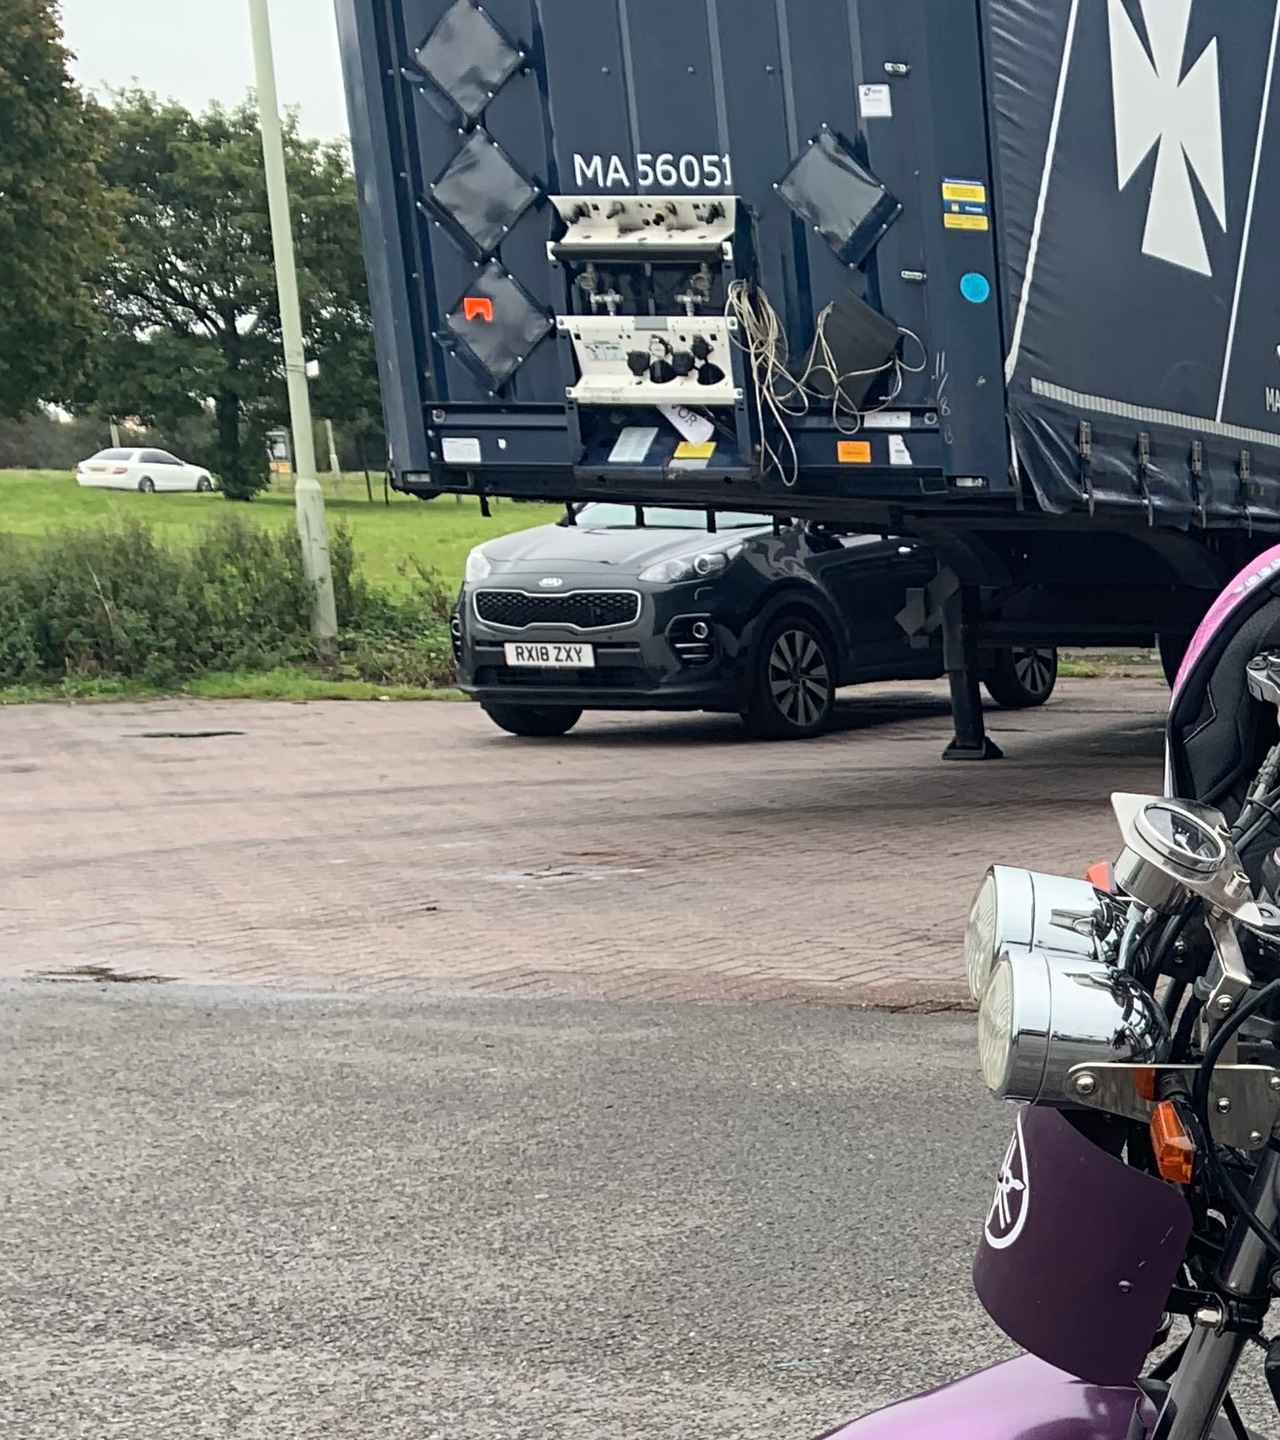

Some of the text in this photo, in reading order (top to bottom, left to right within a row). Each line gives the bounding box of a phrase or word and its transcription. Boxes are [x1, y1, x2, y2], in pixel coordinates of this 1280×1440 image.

[573, 153, 732, 188] MA 56051
[515, 645, 583, 663] RX18 ZXY
